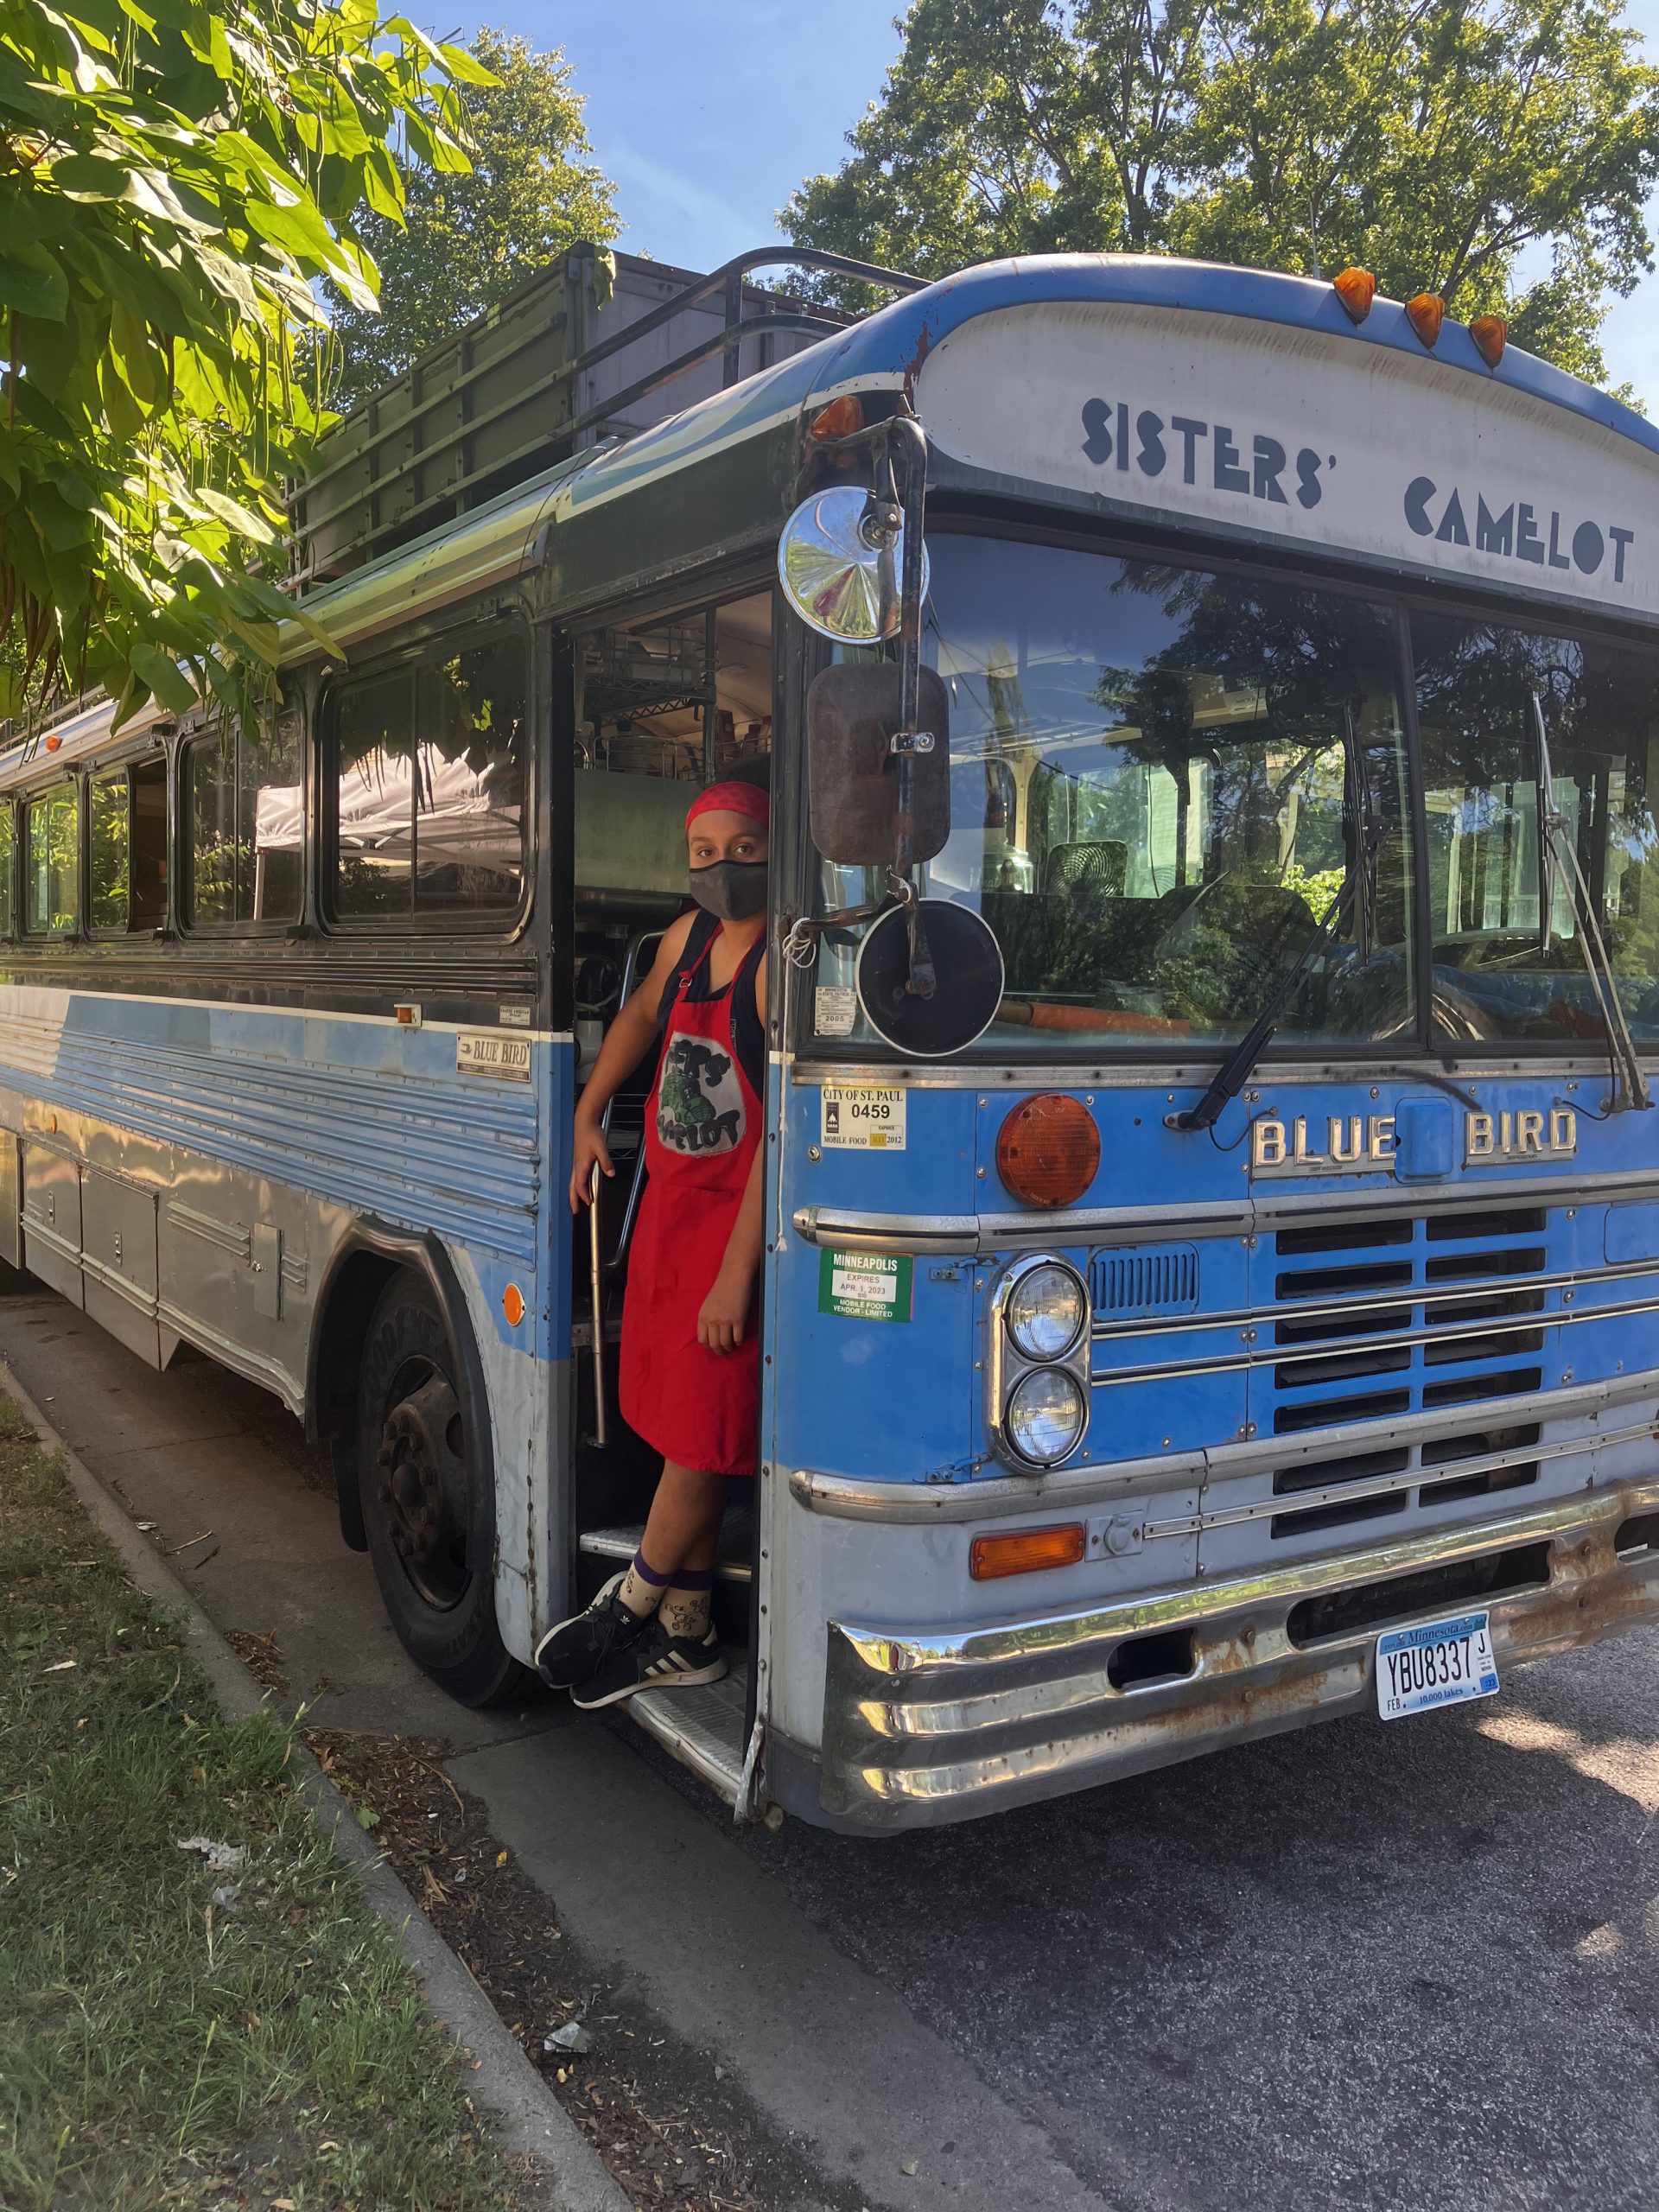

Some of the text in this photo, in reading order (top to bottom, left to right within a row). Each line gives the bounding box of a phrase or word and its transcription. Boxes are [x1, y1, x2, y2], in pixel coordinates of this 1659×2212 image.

[1403, 476, 1635, 583] CAMELOT
[474, 1040, 527, 1065] BLUE BIRD
[823, 1089, 903, 1102] CITY OF ST. PAUL
[851, 1103, 890, 1119] 0459
[823, 1135, 868, 1145] MOBILE FOOD
[1253, 1108, 1576, 1167] BLUE BIRD
[833, 1253, 898, 1272] MINNEAPOLIS
[847, 1273, 880, 1284] EXPIRES
[868, 1286, 886, 1294] 2023
[833, 1305, 861, 1314] VENDOR
[865, 1308, 893, 1318] LIMITED
[839, 1299, 887, 1310] MOBILE FOOD
[1387, 1632, 1485, 1696] YBU8337 J
[1387, 1697, 1401, 1712] FEB
[1444, 1688, 1464, 1700] lakes
